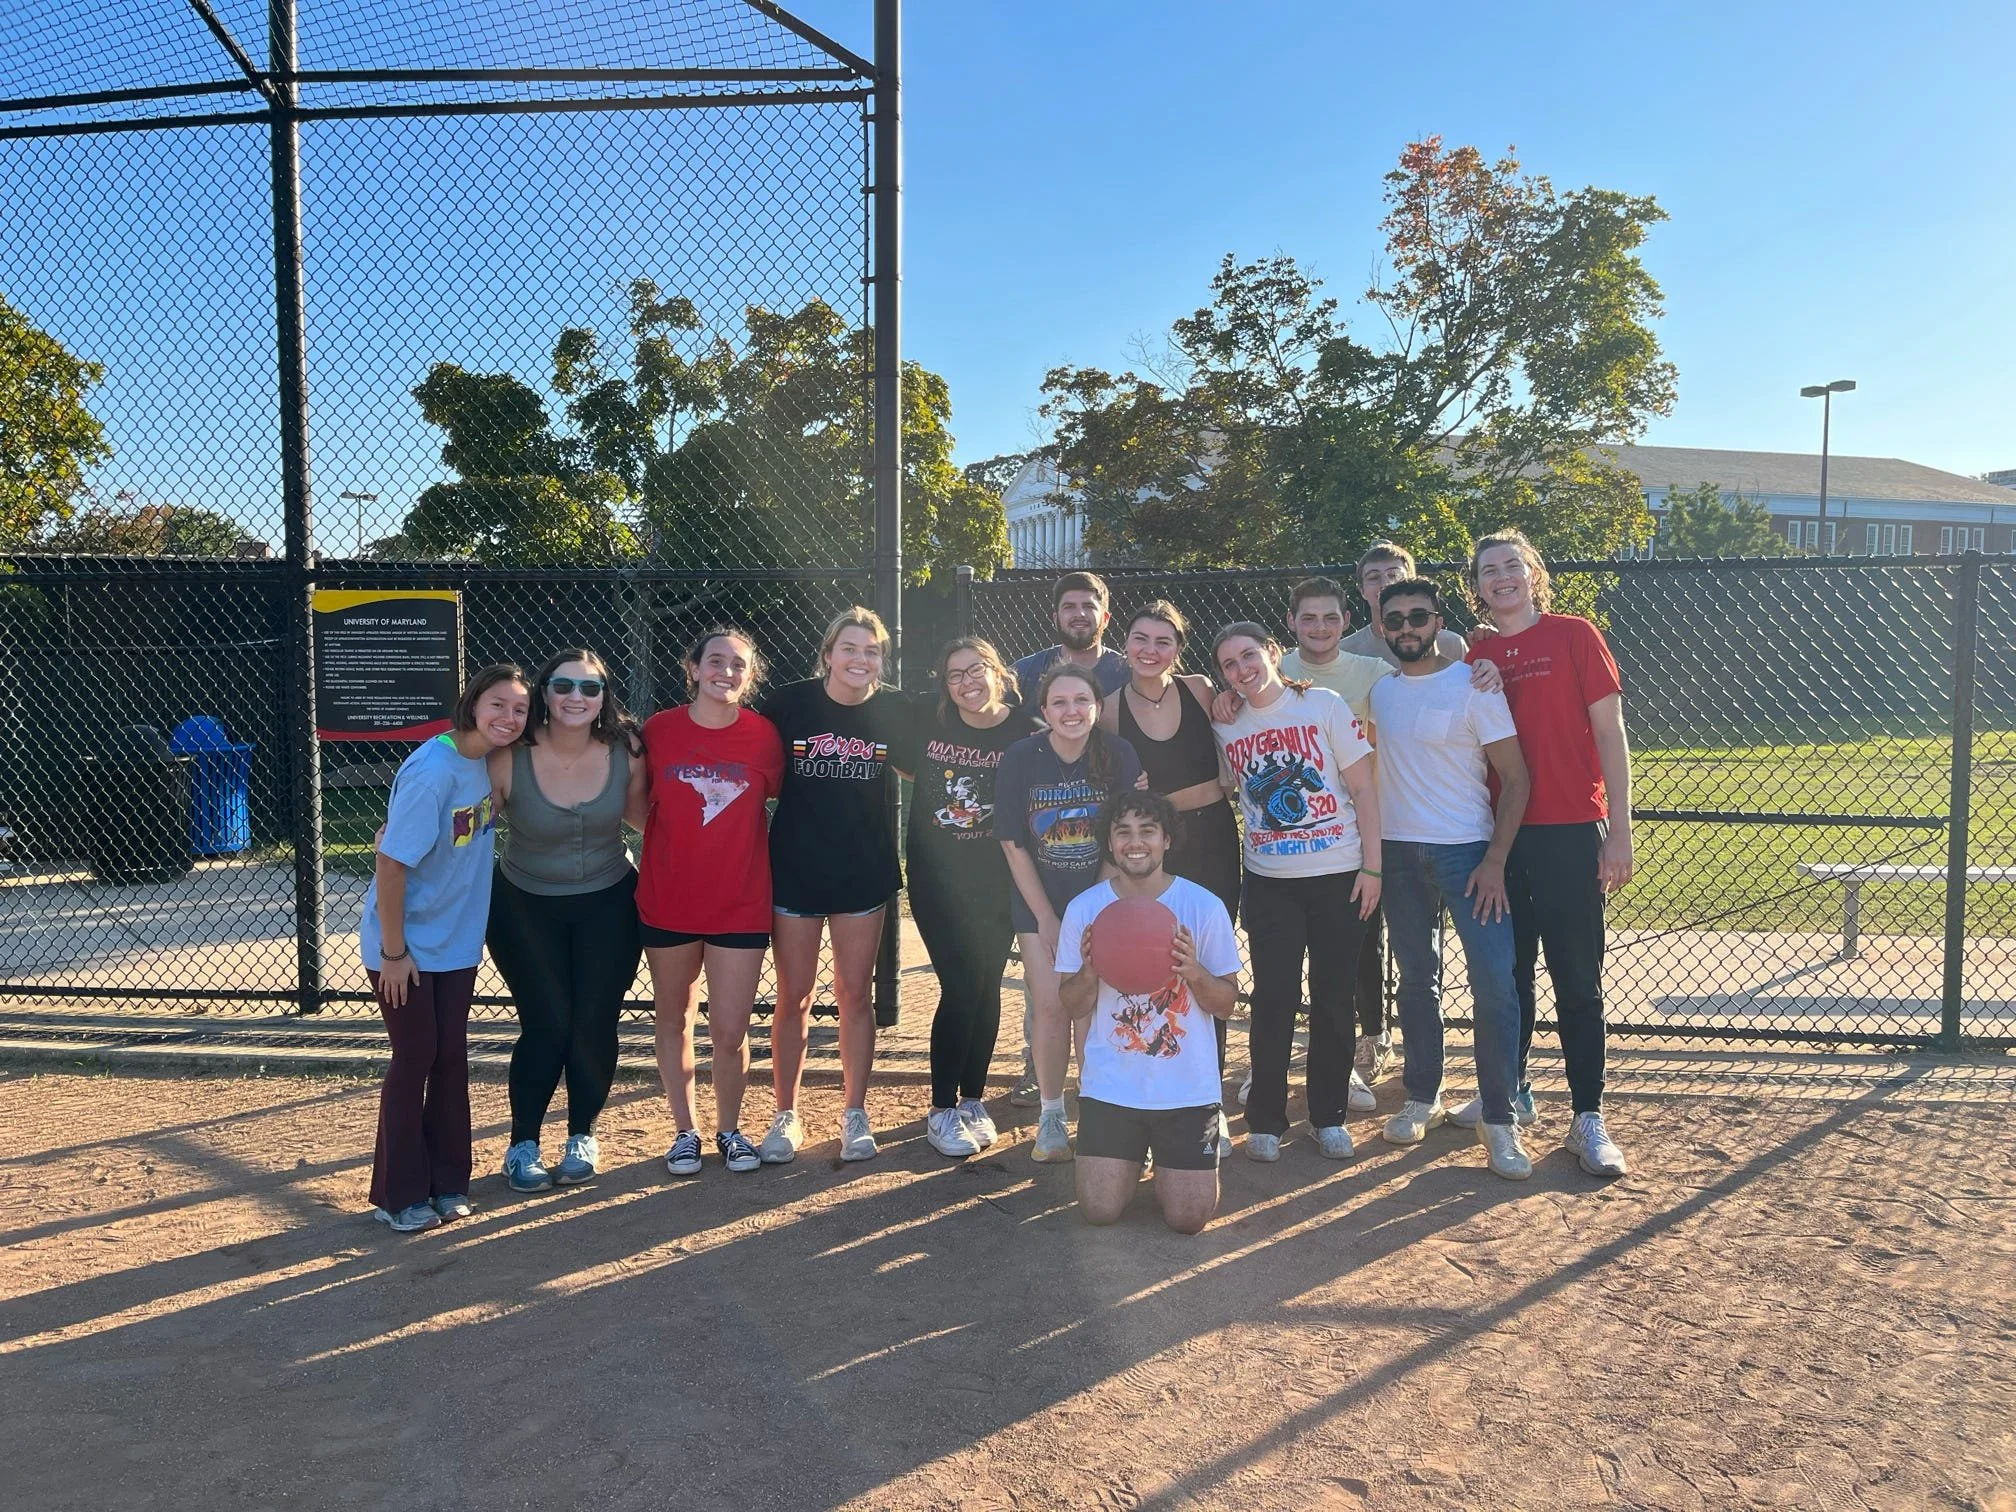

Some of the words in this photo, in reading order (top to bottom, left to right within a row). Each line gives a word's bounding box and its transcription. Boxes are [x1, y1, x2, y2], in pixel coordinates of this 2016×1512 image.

[343, 618, 379, 626] UNIVERSITY
[380, 618, 390, 626] OF
[391, 618, 427, 626] MARYLAND
[807, 733, 875, 764] Terps
[926, 751, 957, 764] MEN'S
[1307, 793, 1337, 819] $20
[1276, 839, 1309, 856] NIGHT
